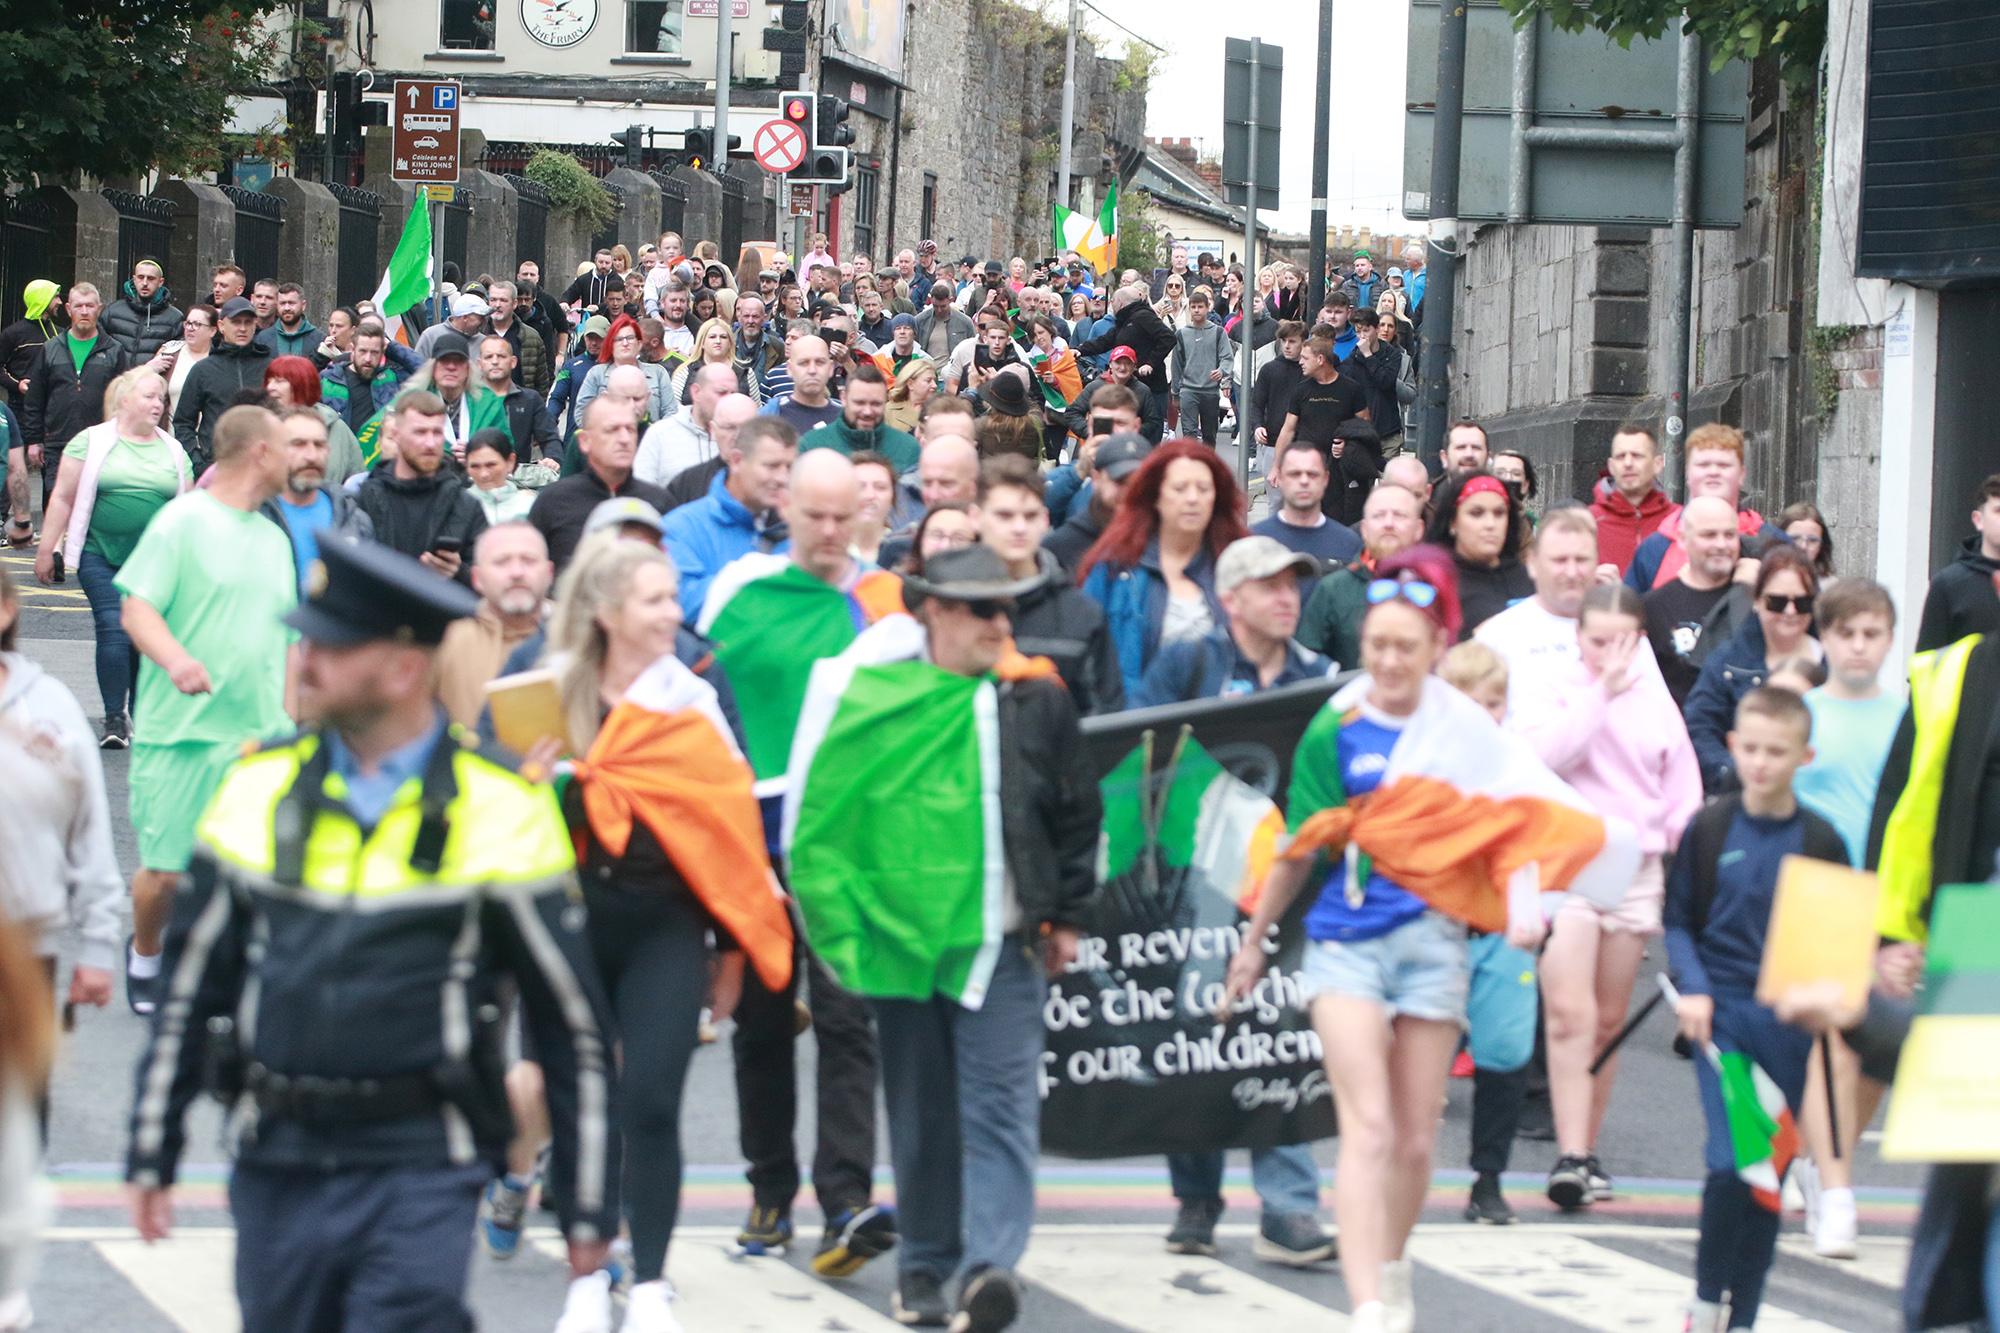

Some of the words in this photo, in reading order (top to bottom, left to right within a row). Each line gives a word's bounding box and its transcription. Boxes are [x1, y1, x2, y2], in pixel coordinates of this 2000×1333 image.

[531, 23, 550, 41] THE
[550, 27, 584, 43] FRIARY
[438, 89, 453, 107] P
[1099, 979, 1176, 1026] the
